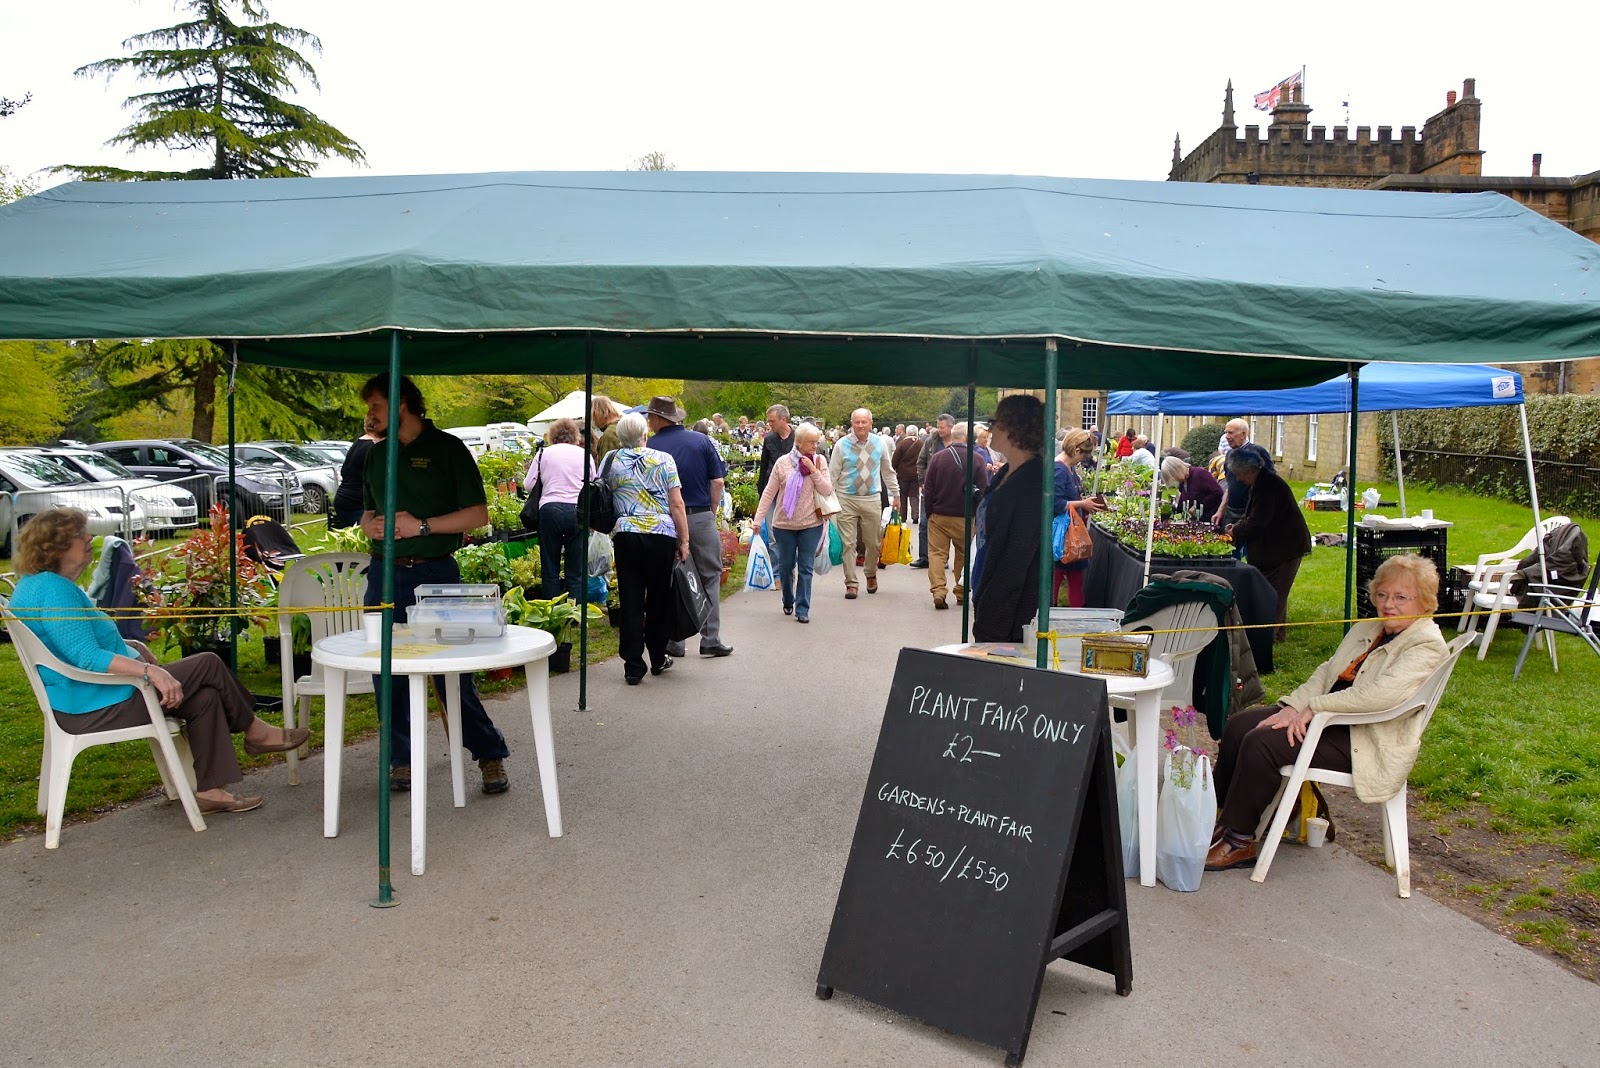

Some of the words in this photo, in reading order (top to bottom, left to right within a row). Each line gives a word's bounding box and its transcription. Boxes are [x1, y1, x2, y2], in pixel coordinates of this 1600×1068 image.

[909, 685, 978, 721] PLANT
[980, 702, 1029, 733] FAIR
[1033, 714, 1086, 744] ONLY
[878, 782, 946, 815] GARDENS
[957, 804, 998, 828] PLANT
[998, 816, 1033, 843] FAIR
